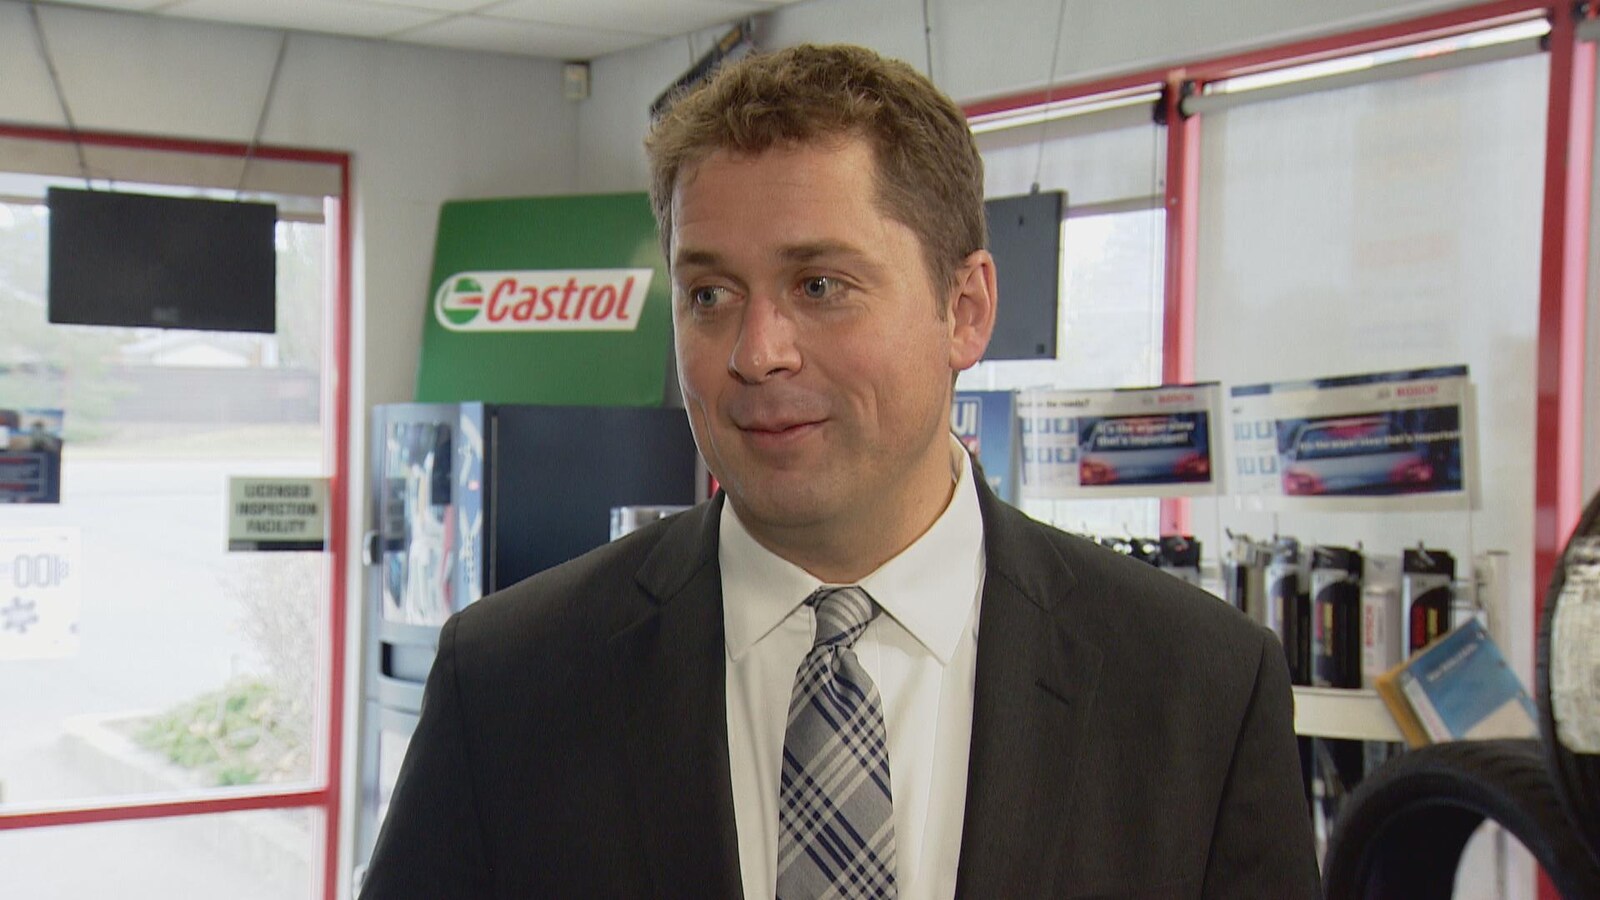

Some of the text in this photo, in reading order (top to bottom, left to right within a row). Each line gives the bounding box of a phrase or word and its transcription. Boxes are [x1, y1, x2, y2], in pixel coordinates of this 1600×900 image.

[486, 276, 635, 322] Castrol
[1397, 384, 1438, 397] BOSCH
[244, 484, 311, 498] LICENSED
[236, 502, 317, 516] INSPECTION
[246, 519, 306, 533] FACILITY
